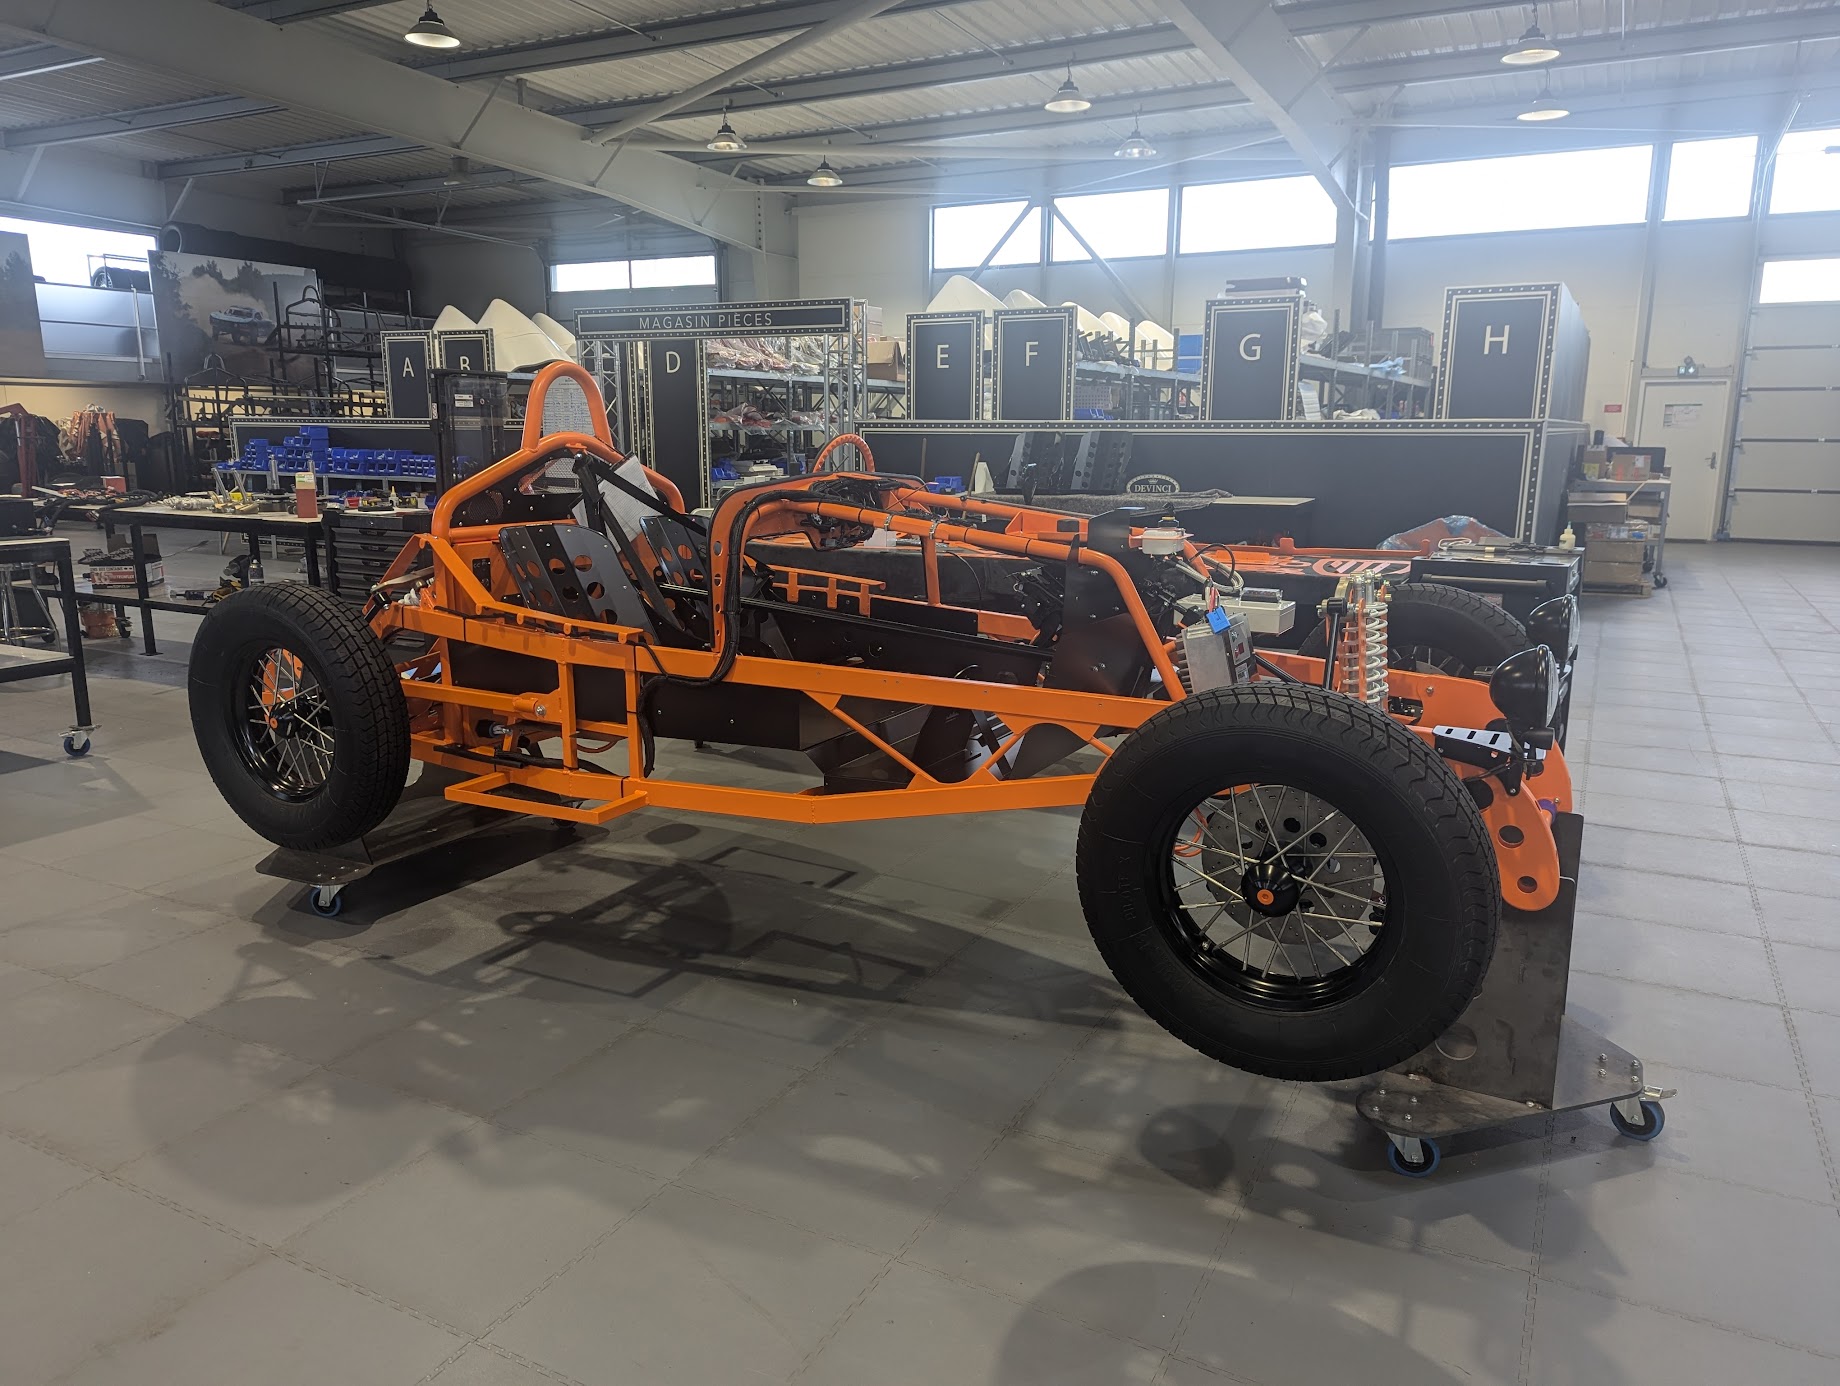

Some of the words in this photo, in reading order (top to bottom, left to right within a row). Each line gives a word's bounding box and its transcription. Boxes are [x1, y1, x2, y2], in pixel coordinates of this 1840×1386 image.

[639, 314, 710, 330] MAGASIN
[718, 311, 773, 327] PIÈCES
[1239, 333, 1262, 361] G
[1483, 324, 1510, 355] H
[666, 350, 682, 374] D
[935, 343, 950, 369] E
[1025, 340, 1039, 367] F
[402, 356, 414, 378] A
[1134, 484, 1172, 493] DEVINCI
